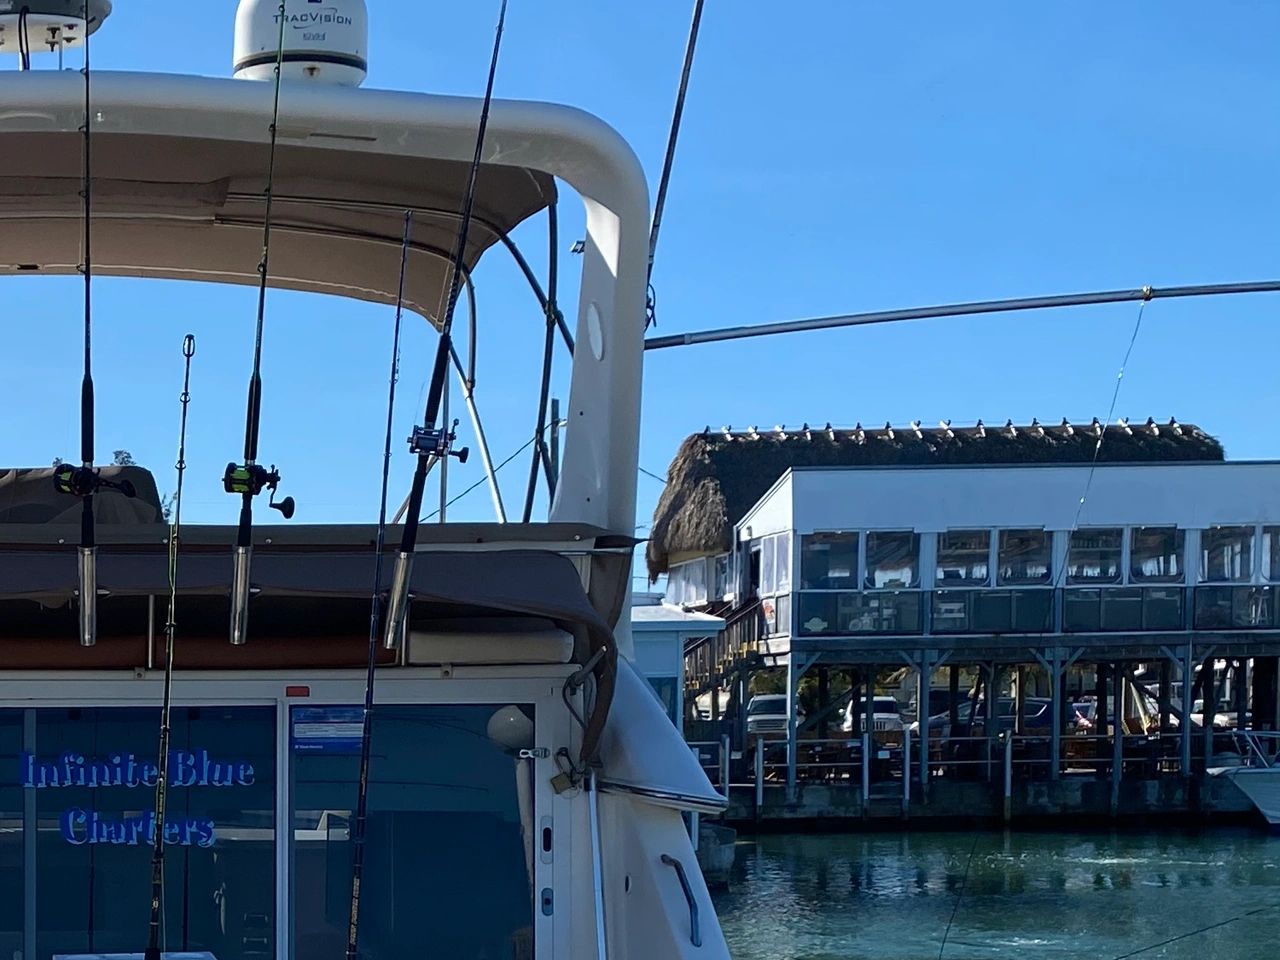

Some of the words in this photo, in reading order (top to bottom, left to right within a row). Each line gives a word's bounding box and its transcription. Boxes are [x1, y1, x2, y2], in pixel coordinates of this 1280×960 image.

[21, 749, 161, 788] Infinite
[168, 748, 255, 788] Blue
[59, 807, 217, 848] Charters
